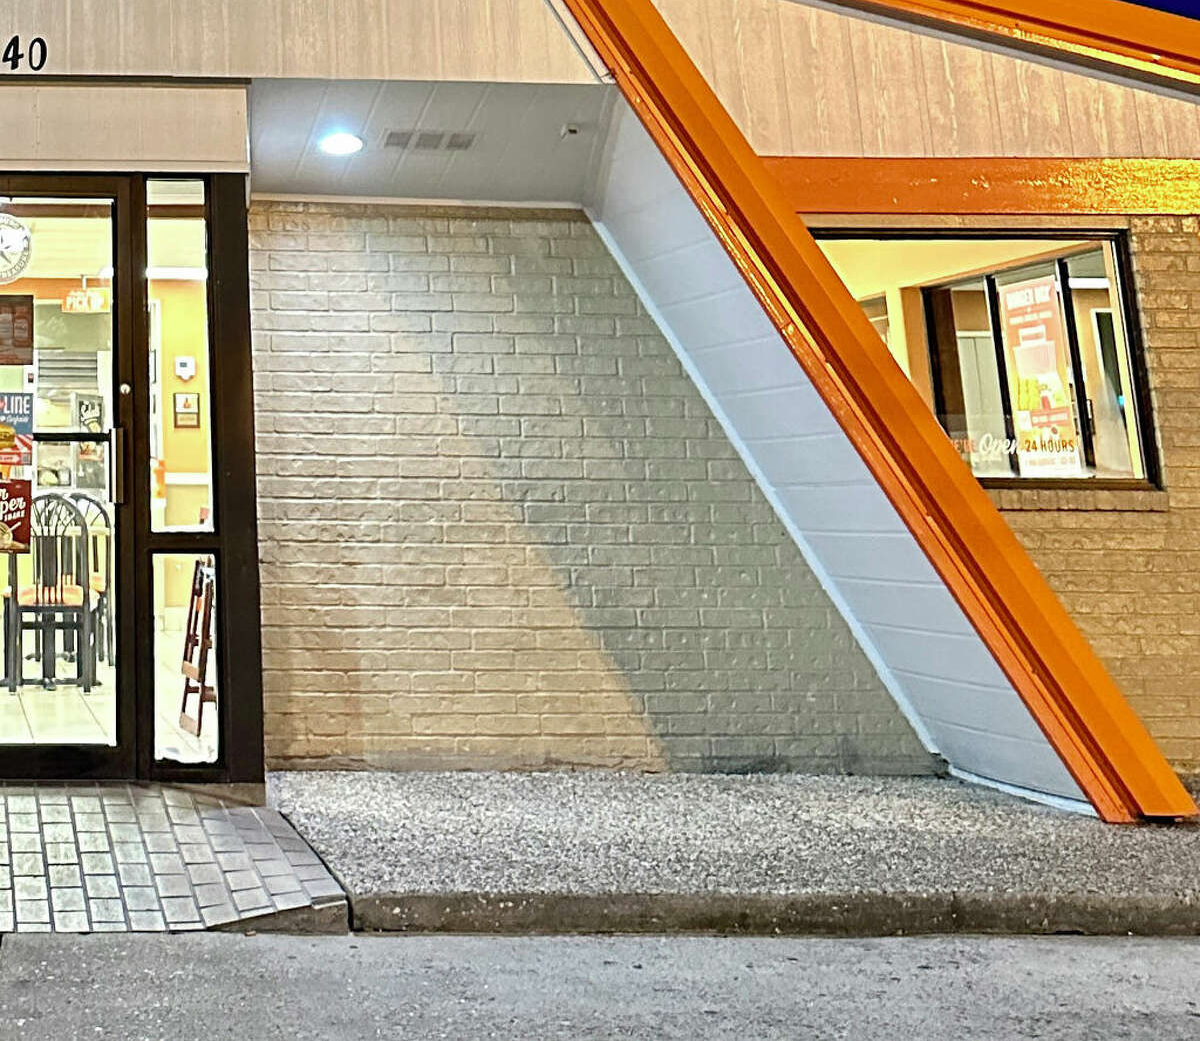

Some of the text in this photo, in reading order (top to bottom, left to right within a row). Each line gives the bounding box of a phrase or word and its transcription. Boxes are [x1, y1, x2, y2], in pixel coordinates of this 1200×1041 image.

[3, 396, 30, 414] LINE
[1024, 439, 1038, 452] 24
[1040, 438, 1075, 453] HOURS
